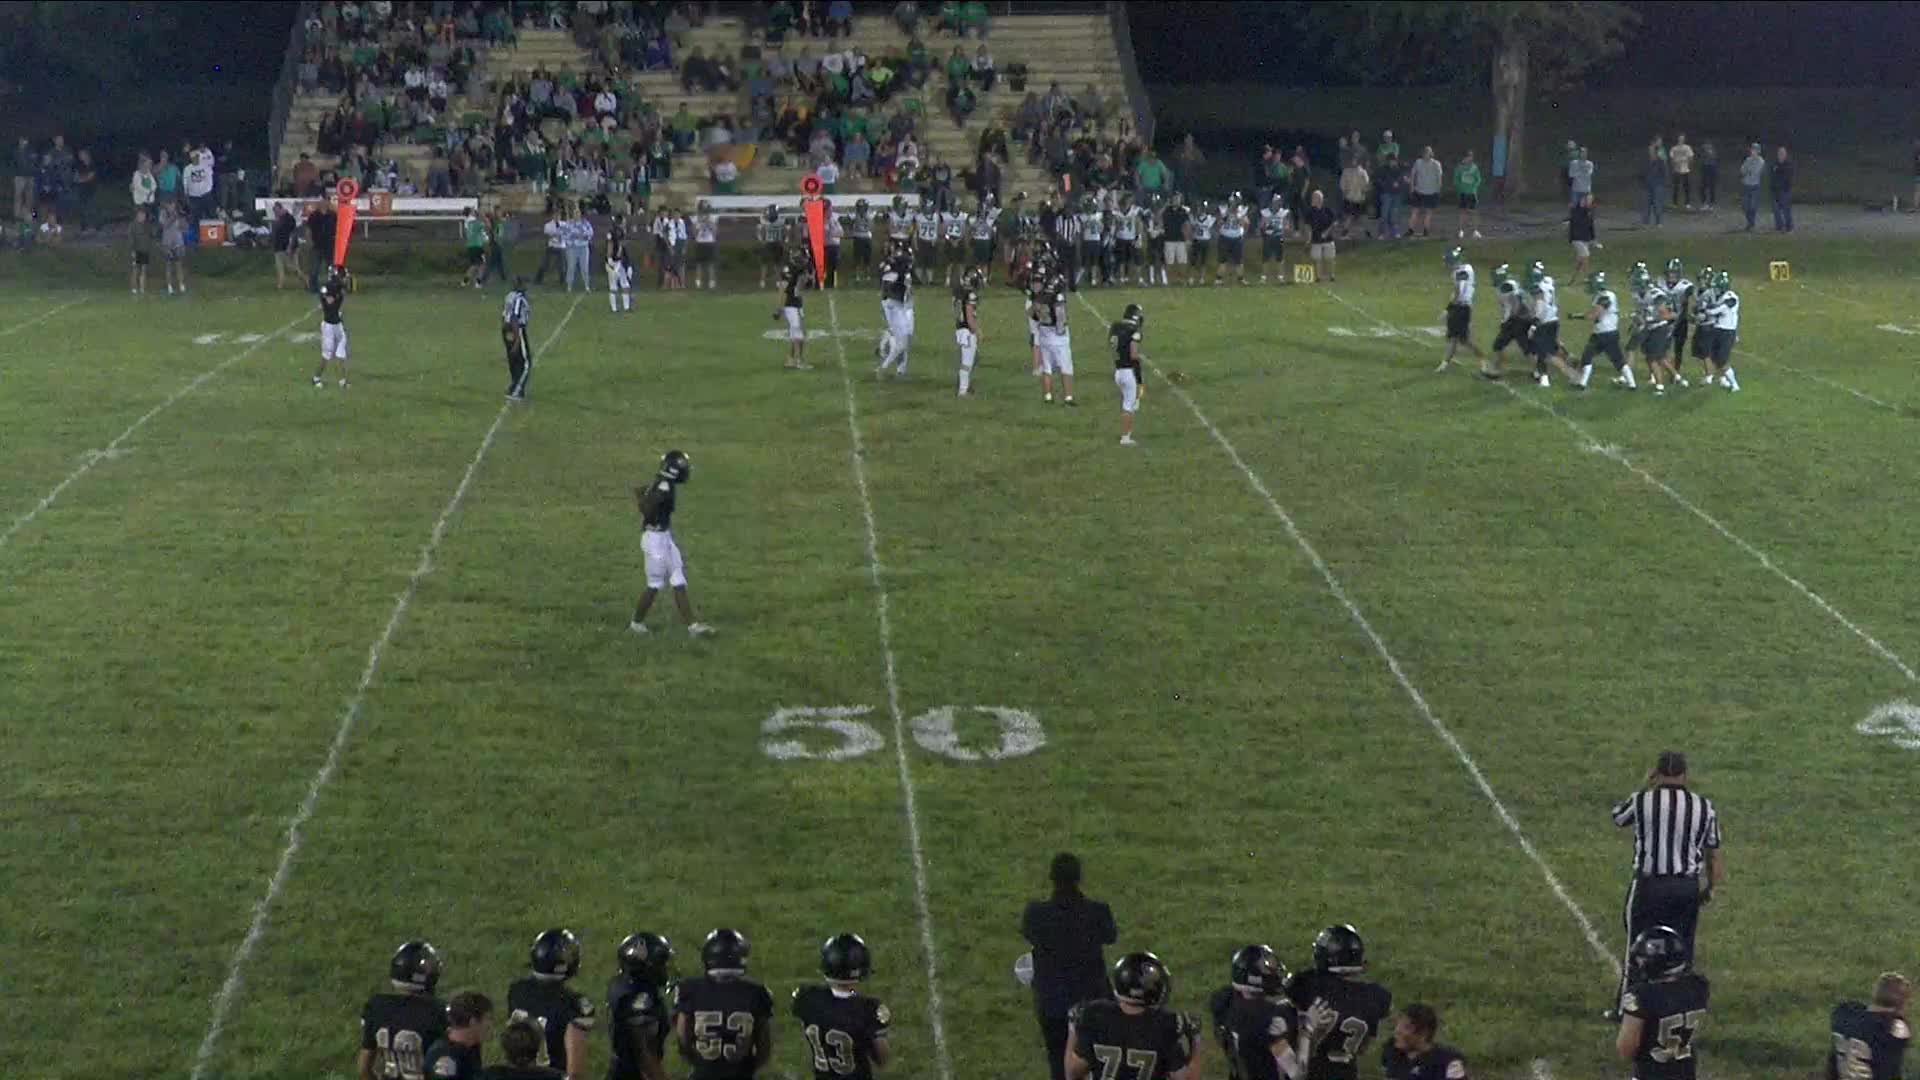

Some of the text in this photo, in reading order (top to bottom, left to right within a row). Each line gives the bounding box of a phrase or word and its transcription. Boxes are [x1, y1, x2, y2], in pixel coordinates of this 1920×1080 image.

[759, 703, 1048, 760] 50
[693, 1011, 755, 1061] 53
[805, 1023, 856, 1075] 13
[1094, 1043, 1158, 1080] 77
[1650, 1008, 1707, 1064] 57
